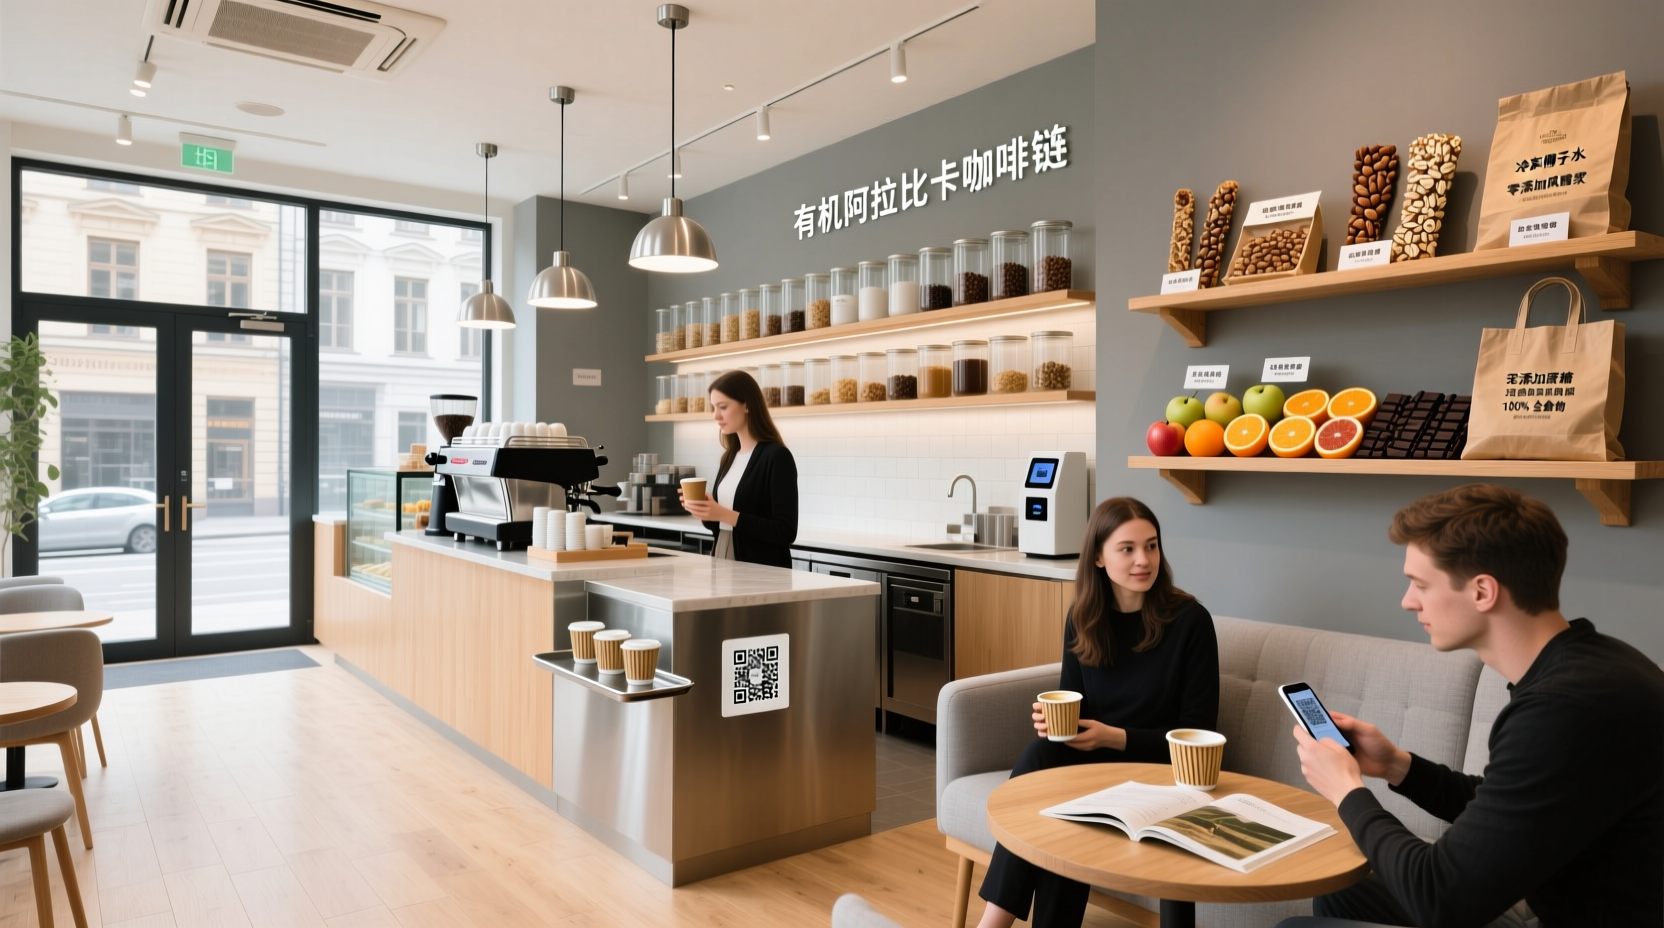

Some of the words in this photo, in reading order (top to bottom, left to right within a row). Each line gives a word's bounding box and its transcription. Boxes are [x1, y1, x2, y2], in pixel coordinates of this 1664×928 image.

[793, 123, 1068, 240] 有机阿拉比卡咖啡链
[1502, 400, 1530, 412] 100%
